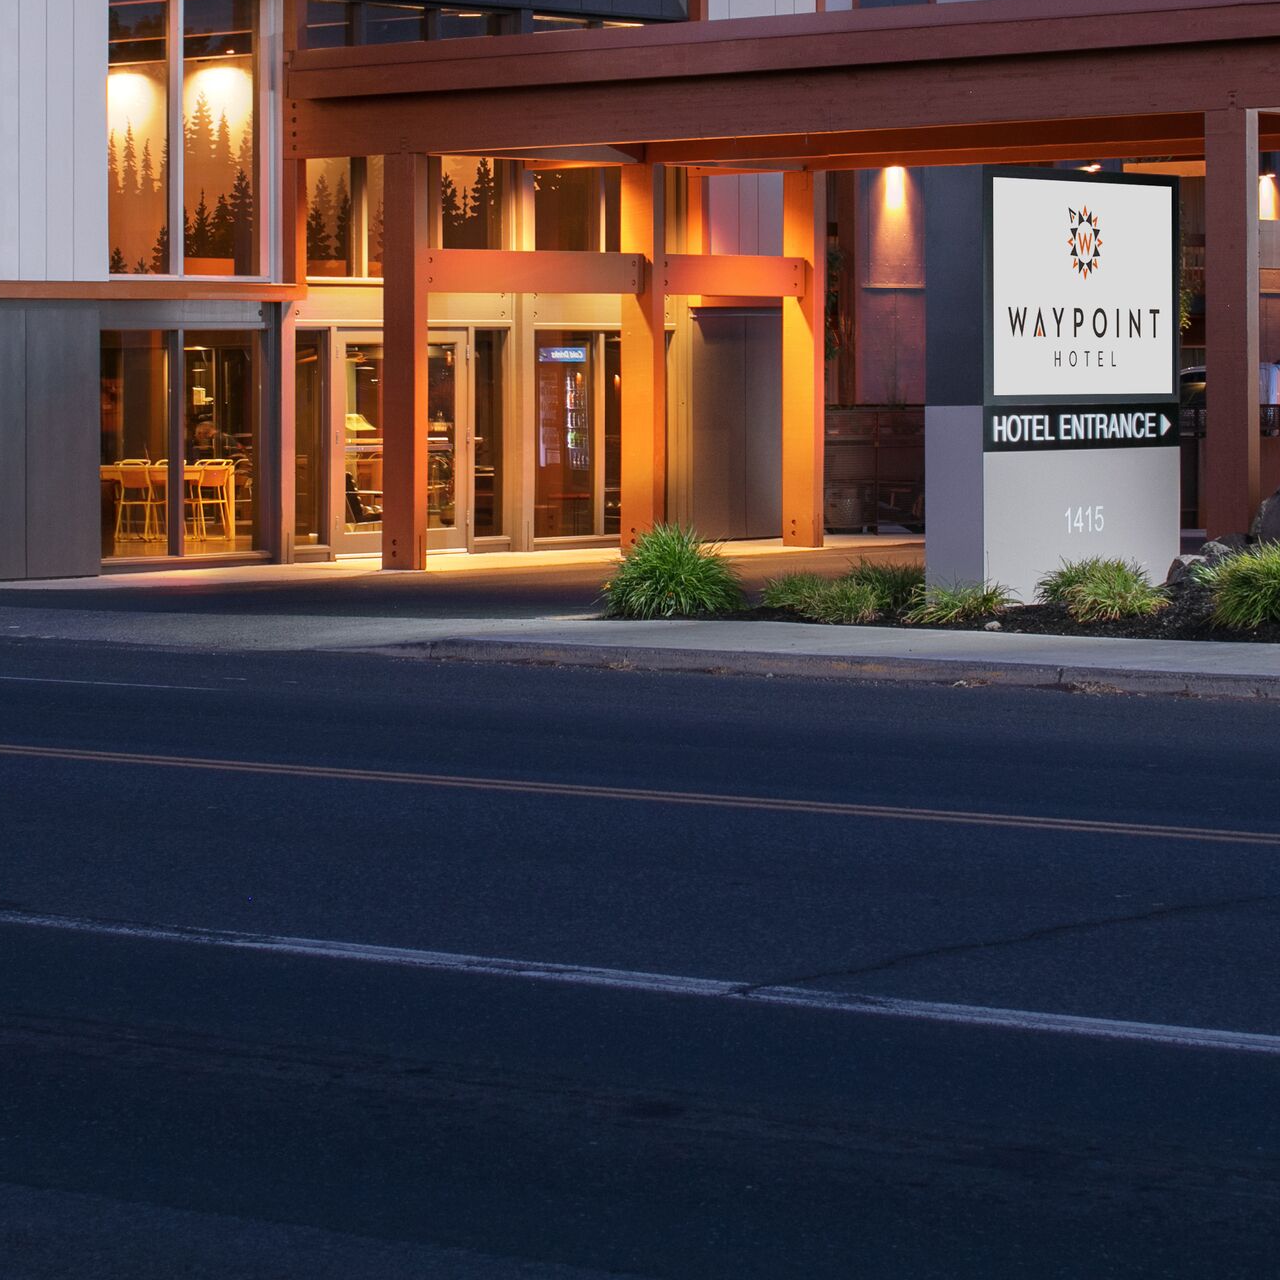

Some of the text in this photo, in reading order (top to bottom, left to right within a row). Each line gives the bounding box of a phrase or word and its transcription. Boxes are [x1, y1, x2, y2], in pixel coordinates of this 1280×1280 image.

[1078, 232, 1093, 256] W
[1007, 306, 1160, 339] WAYPOINT
[1054, 350, 1117, 368] HOTEL
[992, 412, 1157, 443] HOTEL ENTRANCE
[1064, 505, 1105, 534] 1415
